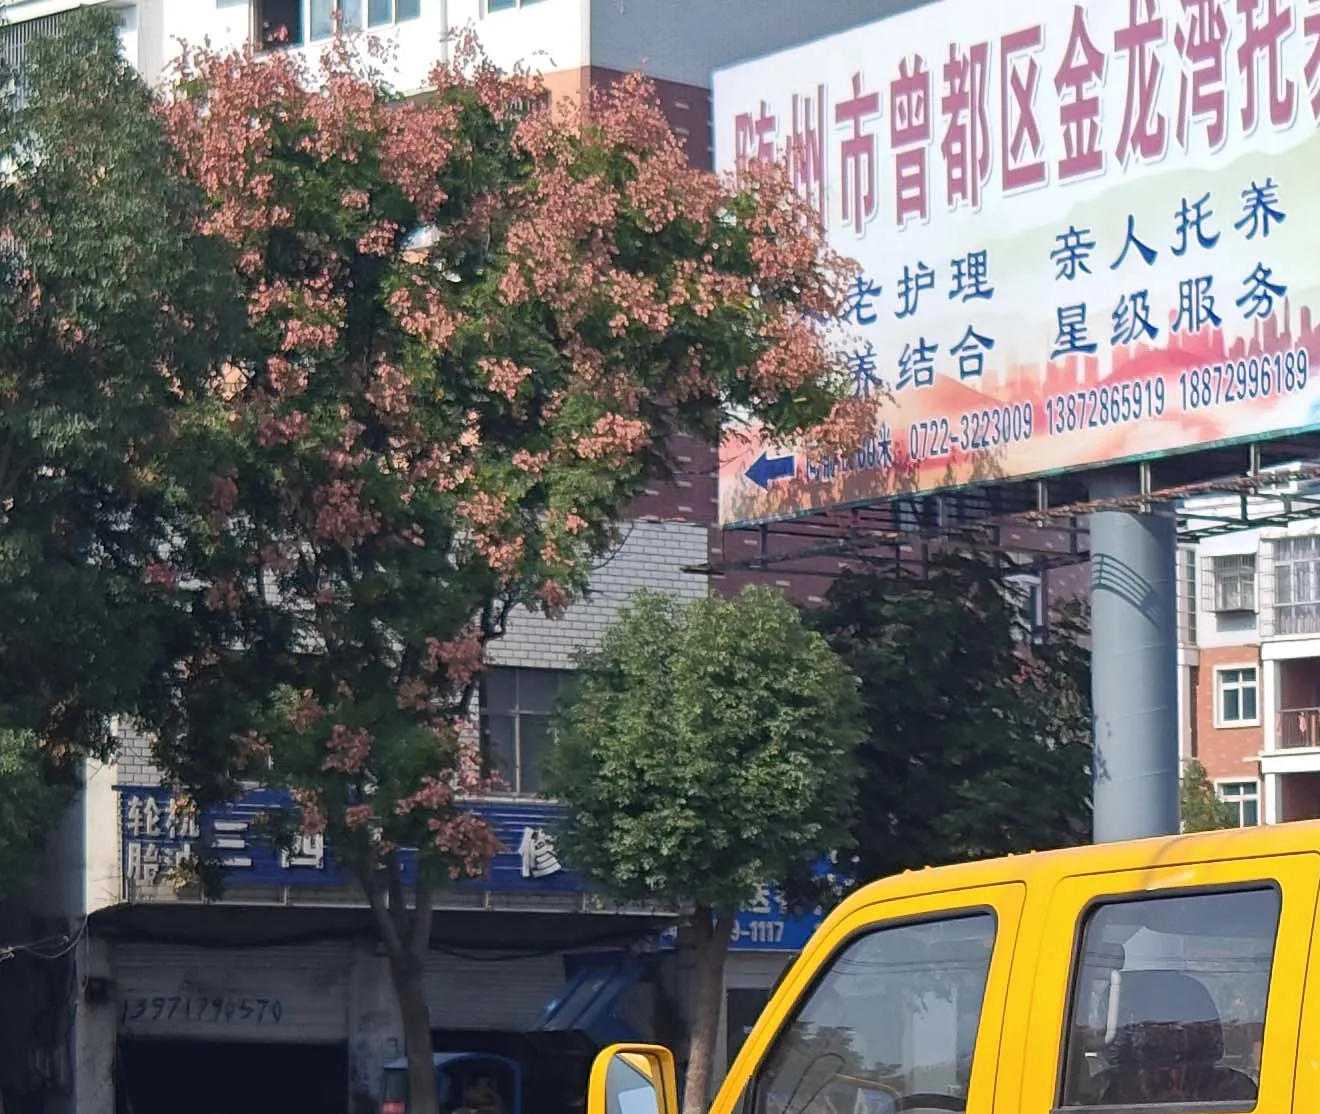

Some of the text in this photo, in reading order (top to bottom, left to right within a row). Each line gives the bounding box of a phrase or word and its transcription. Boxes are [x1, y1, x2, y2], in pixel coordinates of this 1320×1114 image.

[842, 177, 1287, 327] 老护理 亲人托养
[850, 261, 1288, 398] 养结合 星级服务
[909, 402, 1033, 460] 0722-3223009
[1046, 376, 1166, 436] 13872865919
[1179, 350, 1308, 410] 18872996189
